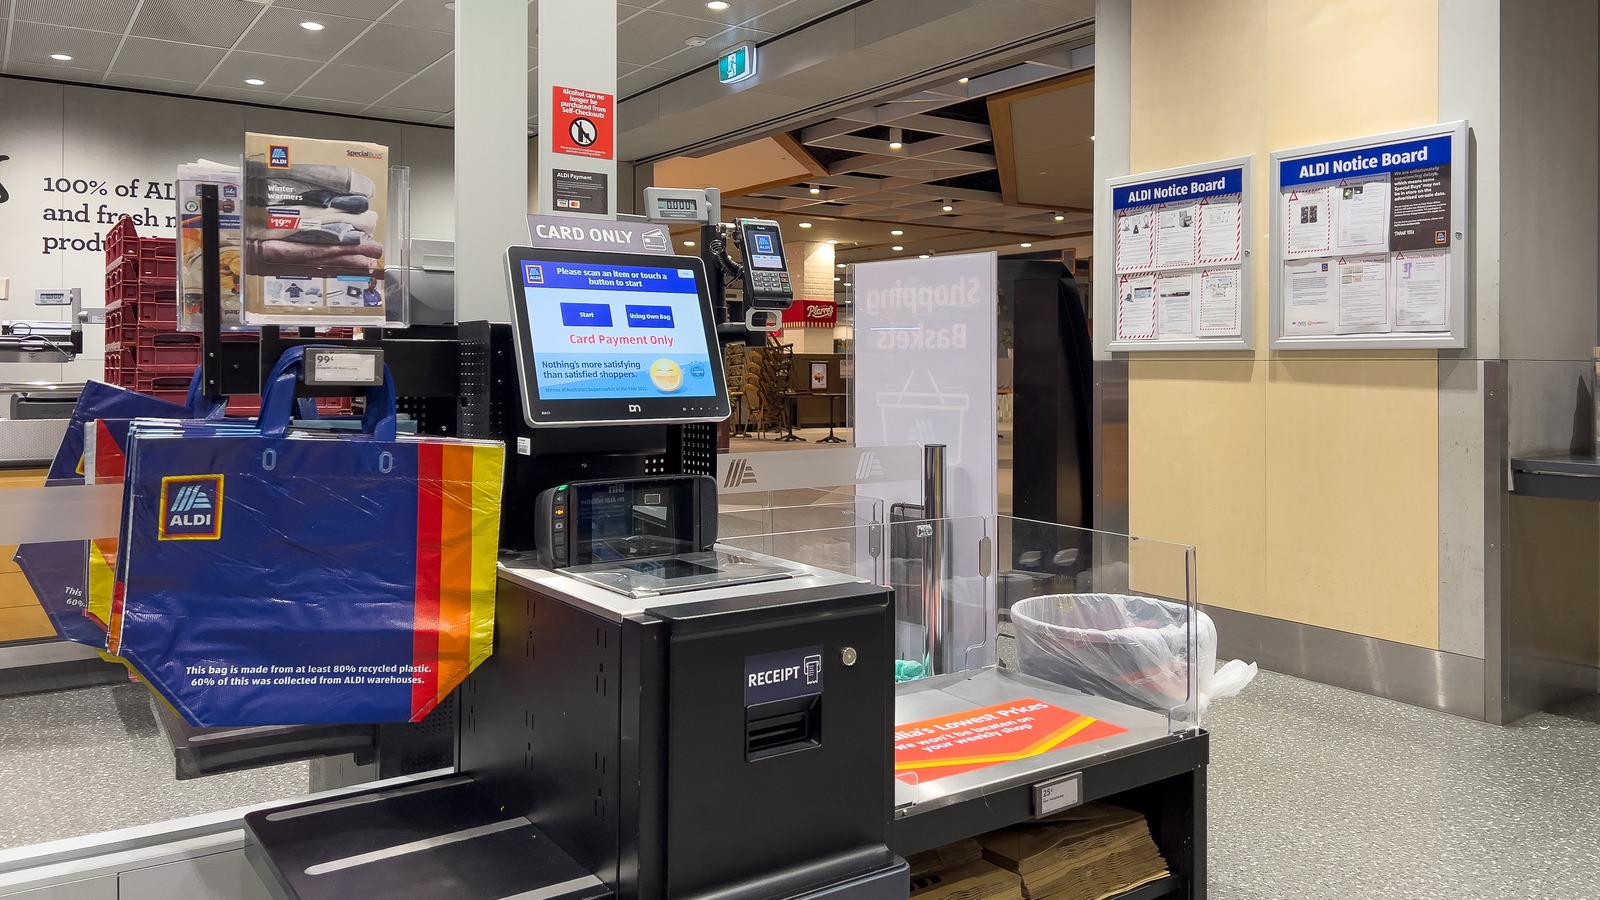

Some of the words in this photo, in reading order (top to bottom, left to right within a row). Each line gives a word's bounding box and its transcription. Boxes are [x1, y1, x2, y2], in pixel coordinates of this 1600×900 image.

[563, 89, 584, 97] Alcohol
[570, 96, 589, 105] longer
[561, 101, 591, 110] purchased
[592, 105, 606, 113] from
[562, 107, 604, 118] Self-Checkouts
[1299, 162, 1330, 178] ALDI
[1333, 156, 1378, 172] Notice
[1382, 146, 1428, 167] Board
[43, 178, 108, 196] 100%
[115, 179, 140, 198] of
[268, 185, 294, 193] Winter
[1128, 189, 1151, 203] ALDI
[1154, 184, 1188, 199] Notice
[1191, 177, 1225, 194] Board
[43, 204, 90, 223] and
[536, 224, 585, 240] CARD
[589, 228, 632, 244] ONLY
[556, 268, 582, 276] Please
[613, 270, 630, 278] item
[641, 271, 661, 279] touch
[588, 278, 614, 286] button
[570, 334, 595, 344] Card
[599, 334, 648, 346] Payment
[650, 335, 674, 347] Only
[542, 361, 580, 370] Nothing's
[604, 360, 641, 370] satisfying
[564, 370, 598, 378] satisfied
[599, 371, 638, 380] shoppers.
[169, 515, 211, 526] ALDI
[65, 586, 82, 596] This
[186, 667, 206, 675] This
[209, 666, 227, 676] bag
[230, 666, 238, 674] is
[241, 666, 268, 674] made
[271, 665, 293, 673] from
[308, 665, 331, 673] least
[334, 665, 356, 673] 80%
[359, 664, 397, 674] recycled
[399, 664, 431, 674] plastic.
[191, 678, 215, 686] 60%
[218, 677, 229, 685] of
[231, 677, 249, 685] this
[274, 676, 317, 684] collected
[320, 676, 342, 684] from
[344, 676, 364, 684] ALDI
[367, 676, 424, 684] warehouses.
[749, 666, 800, 687] RECEIPT
[933, 713, 1000, 731] Lowest
[996, 703, 1049, 717] Prices
[916, 733, 955, 745] won't
[970, 720, 1017, 733] beaten
[921, 742, 954, 753] your
[954, 730, 1002, 744] weekly
[1001, 724, 1033, 734] shop
